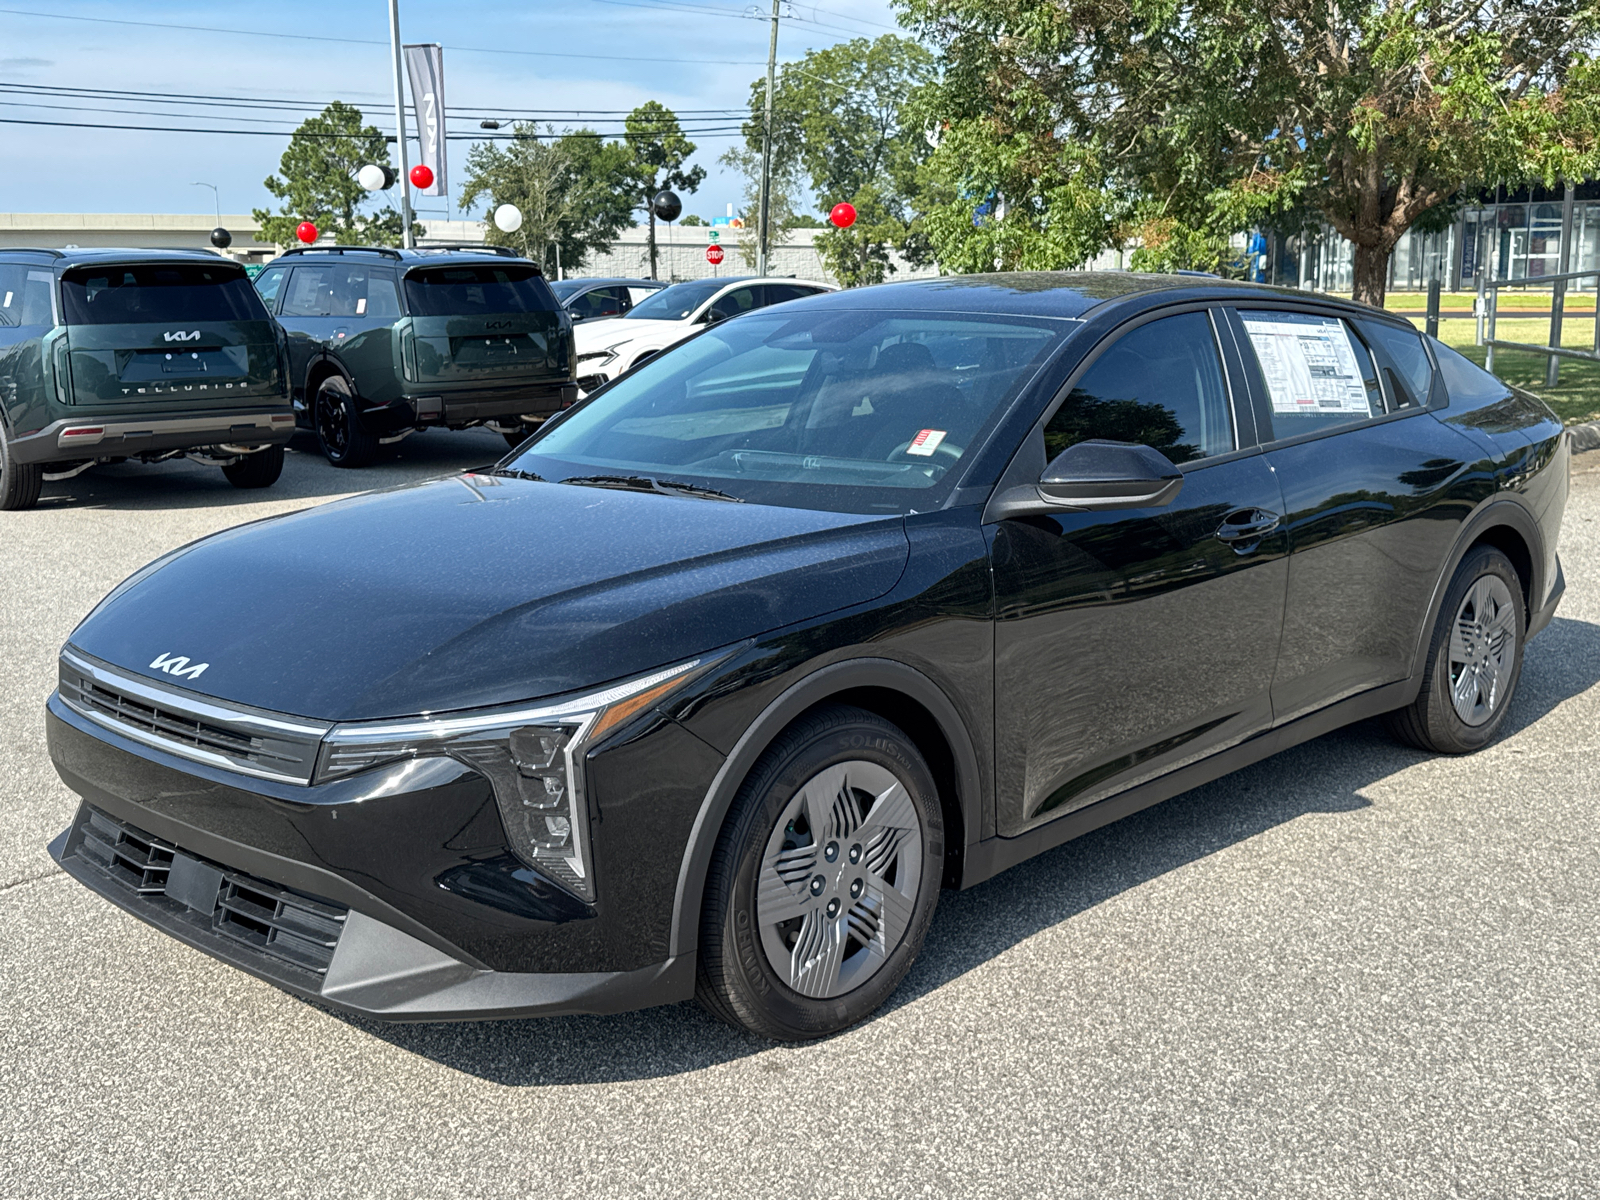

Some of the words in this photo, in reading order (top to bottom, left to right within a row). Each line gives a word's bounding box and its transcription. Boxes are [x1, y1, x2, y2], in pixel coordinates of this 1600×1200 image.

[707, 250, 724, 260] STOP
[485, 320, 512, 329] KIA
[163, 330, 201, 342] KIA
[121, 381, 248, 395] TELLURIDE
[149, 651, 210, 680] KIA
[839, 734, 899, 757] SOLUS
[737, 909, 772, 998] KUMHO
